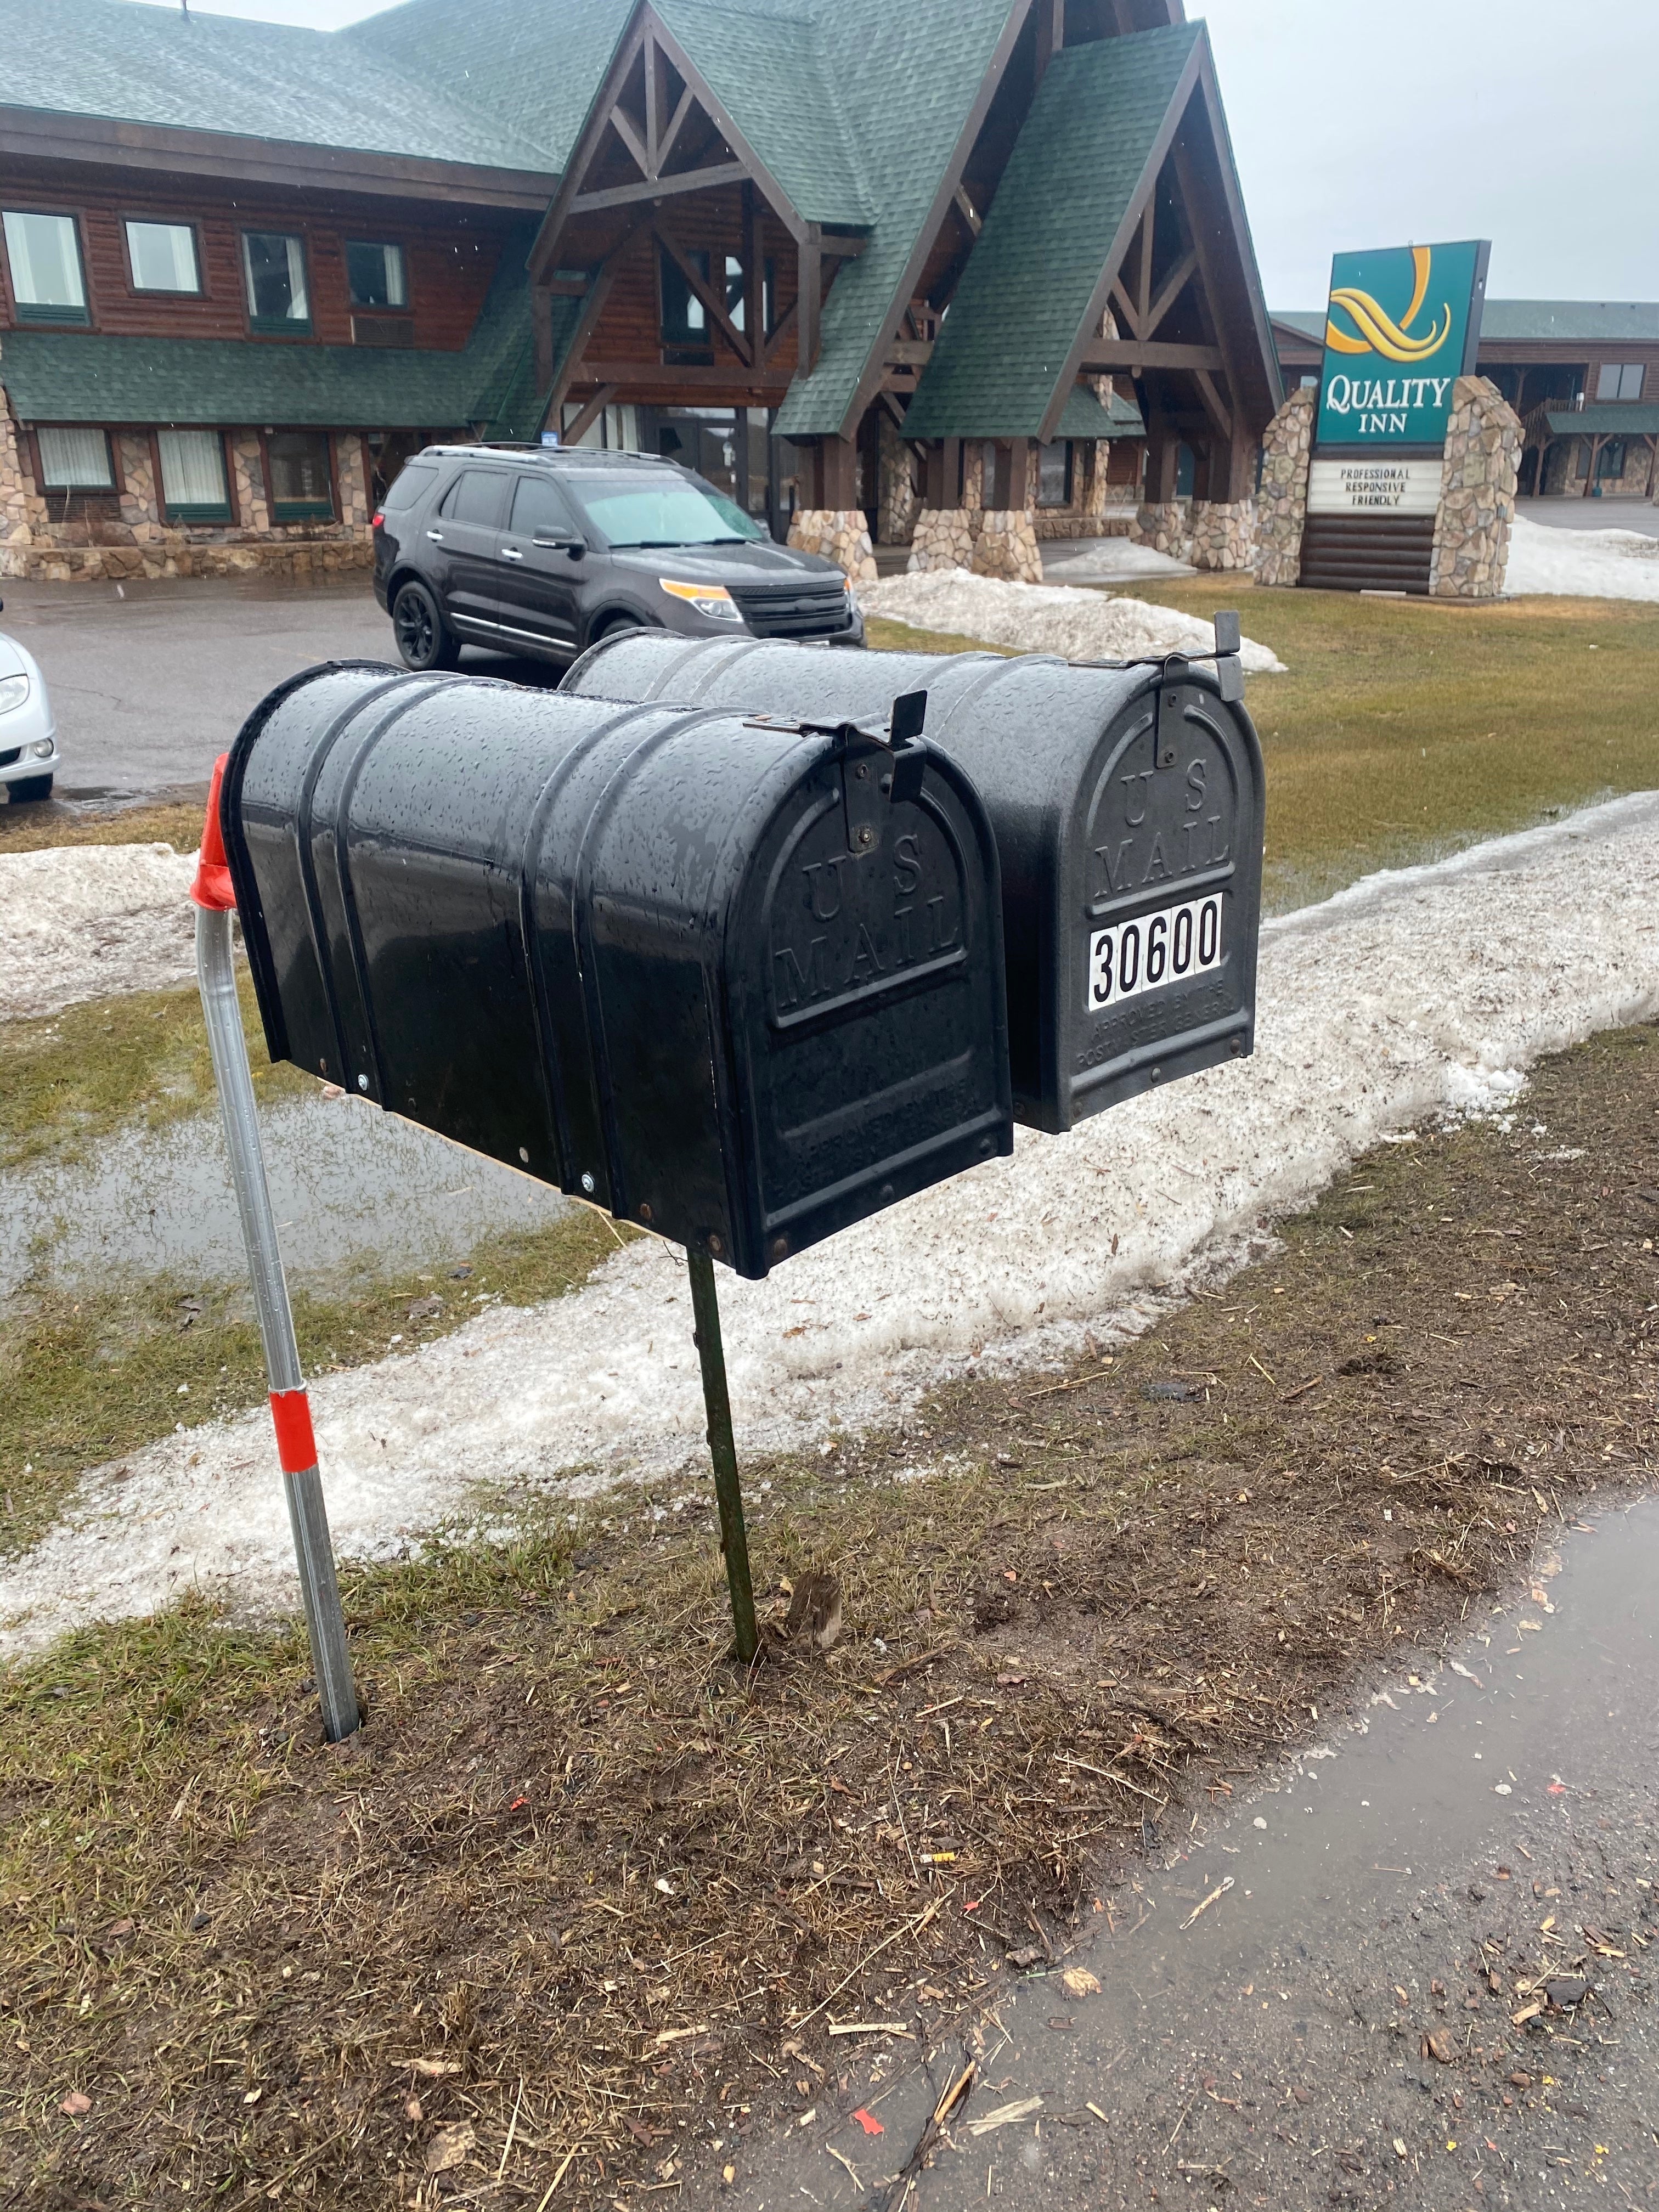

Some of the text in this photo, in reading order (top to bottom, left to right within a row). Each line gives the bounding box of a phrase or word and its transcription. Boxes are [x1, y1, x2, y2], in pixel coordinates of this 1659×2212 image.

[1327, 374, 1451, 414] QUALITY
[1358, 413, 1408, 433] INN
[1340, 468, 1410, 480] PROFESSIONAL
[1345, 482, 1406, 493] RESPONSIVE
[1352, 495, 1400, 506] FRIENDLY
[1094, 815, 1229, 899] MAIL
[775, 895, 959, 1008] MAIL
[1094, 900, 1218, 1003] 30600
